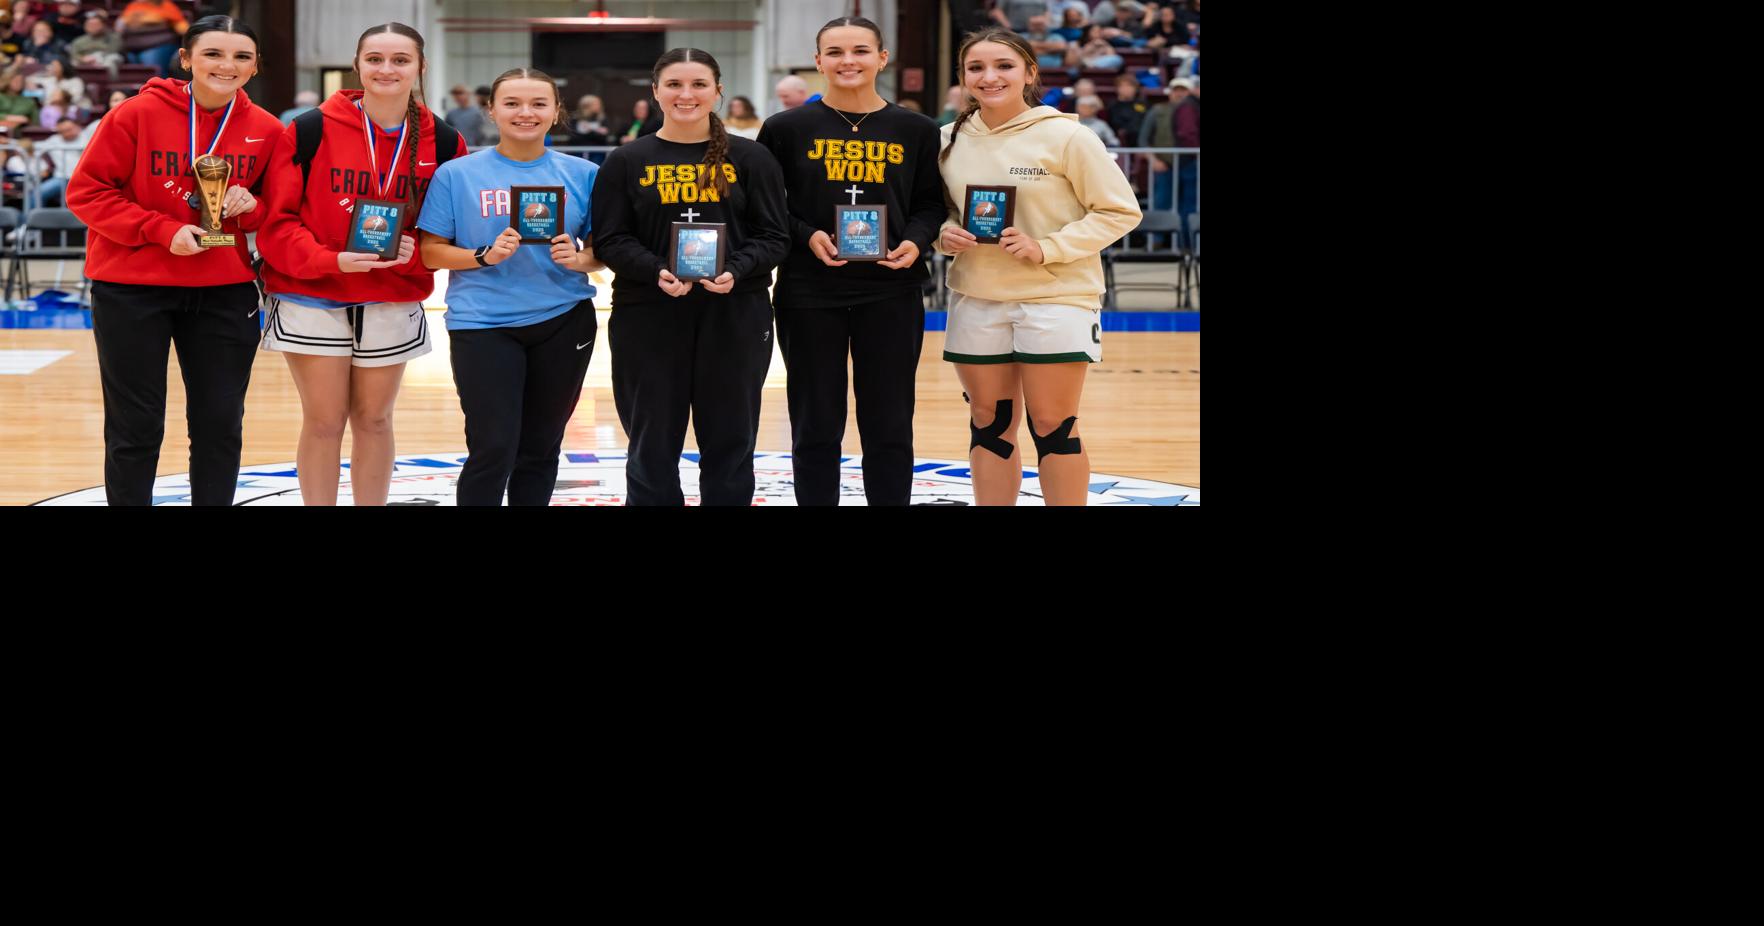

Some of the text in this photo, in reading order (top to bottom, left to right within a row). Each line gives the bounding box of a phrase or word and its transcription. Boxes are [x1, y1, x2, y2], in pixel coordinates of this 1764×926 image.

[808, 139, 904, 164] JESUS
[825, 160, 886, 183] WON
[522, 192, 557, 202] PITT 8
[657, 182, 720, 204] WON
[973, 191, 1006, 202] PITT 8
[363, 204, 389, 216] PITT
[390, 208, 398, 217] 8
[843, 211, 878, 220] PITT 8
